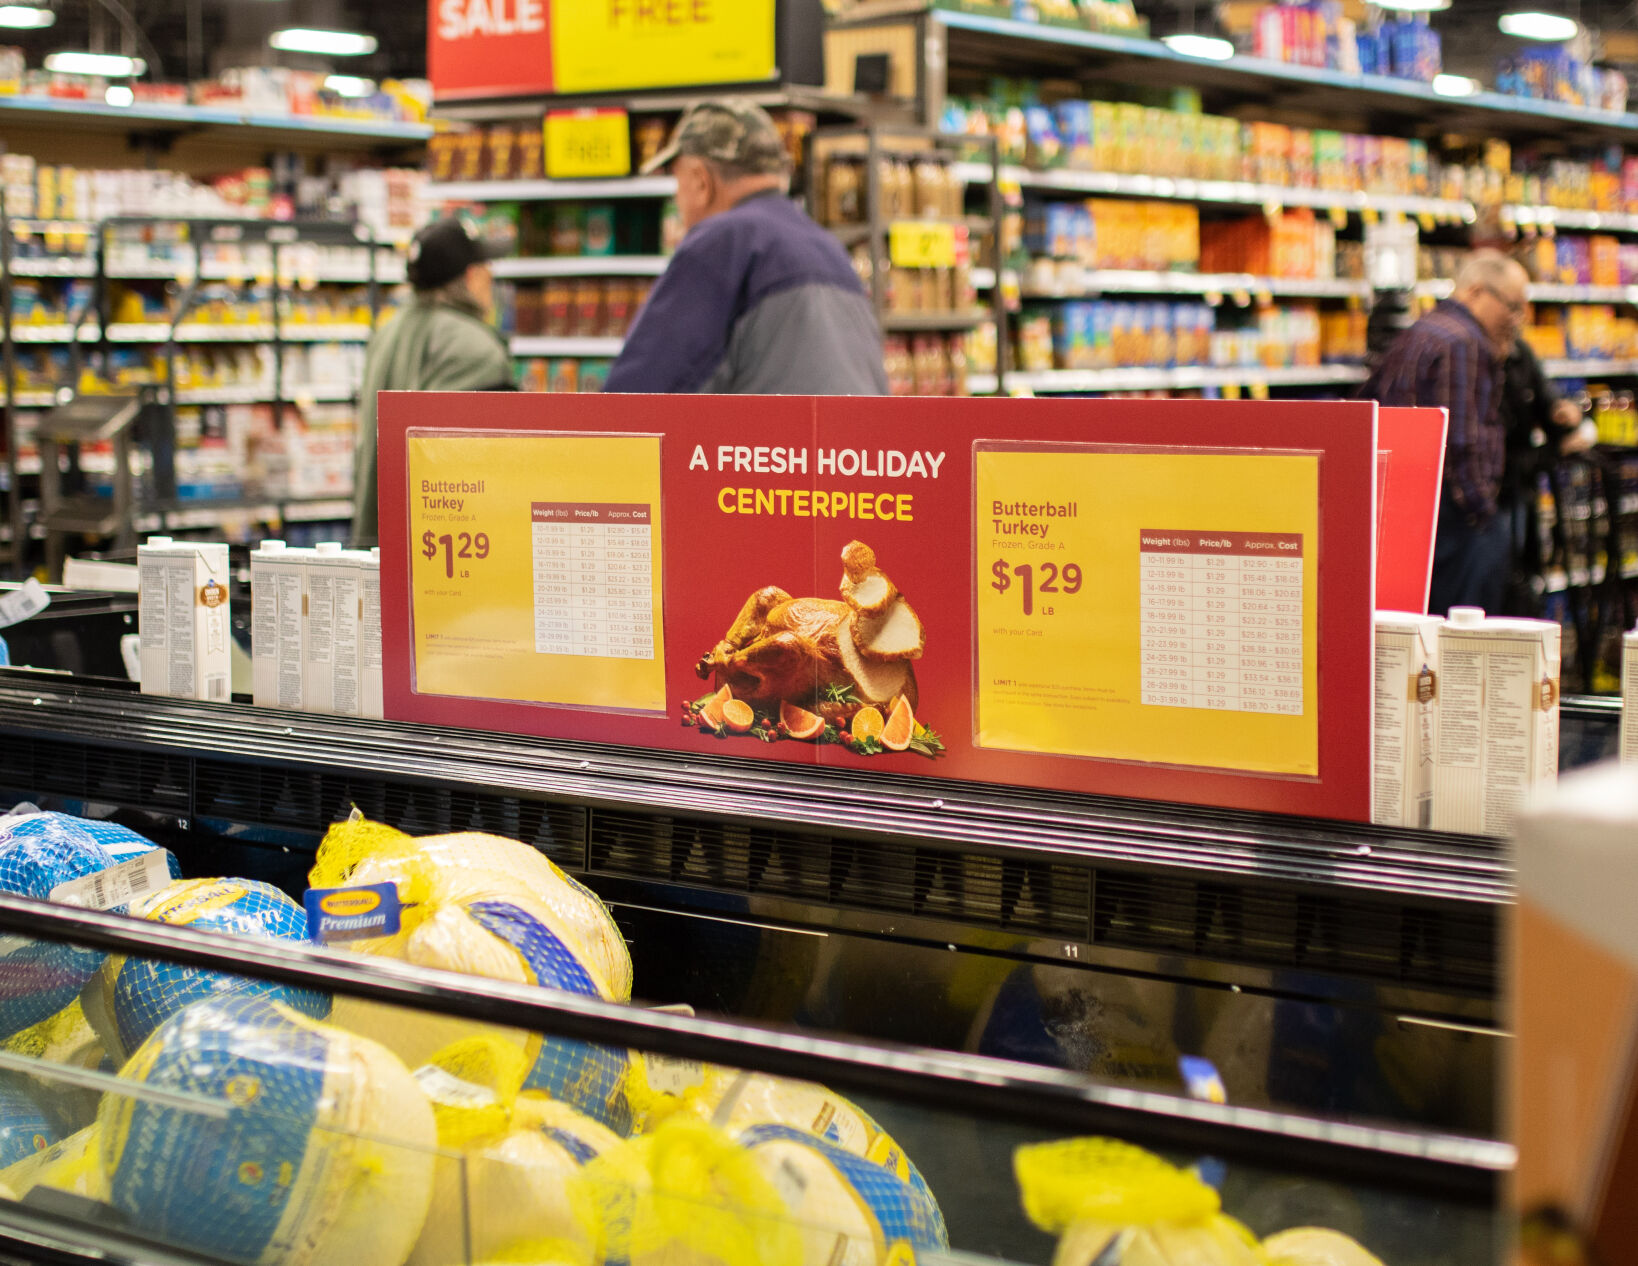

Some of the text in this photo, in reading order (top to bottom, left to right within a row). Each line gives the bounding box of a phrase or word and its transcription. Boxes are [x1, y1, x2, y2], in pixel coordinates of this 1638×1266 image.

[438, 0, 544, 39] SALE
[689, 445, 945, 478] A FRESH HOLIDAY
[422, 480, 485, 493] Butterball
[422, 496, 464, 512] Turkey
[718, 487, 913, 521] CENTERPIECE
[993, 501, 1077, 517] Butterball
[992, 520, 1049, 538] Turkey
[992, 540, 1065, 550] Frozen, Grade A
[1142, 538, 1297, 550] Weight (lbs) Price/lb Approx. Cost
[1207, 558, 1224, 566] $1.29
[460, 570, 469, 578] LB
[1207, 572, 1224, 581] $1.29
[1207, 586, 1224, 595] $1.29
[1207, 601, 1224, 609] $1.29
[1042, 607, 1054, 615] LB
[1207, 615, 1224, 623] $1.29
[1026, 629, 1042, 637] Card
[1207, 629, 1225, 637] $1.29
[1207, 643, 1225, 651] $1.29
[1207, 657, 1225, 665] $1.29
[1208, 671, 1225, 679] $1.29
[1208, 685, 1225, 693] $1.29
[1180, 697, 1187, 705] lb
[1208, 699, 1225, 707] $1.29
[177, 818, 188, 830] 12
[319, 914, 386, 931] Premium
[1064, 944, 1078, 959] 11
